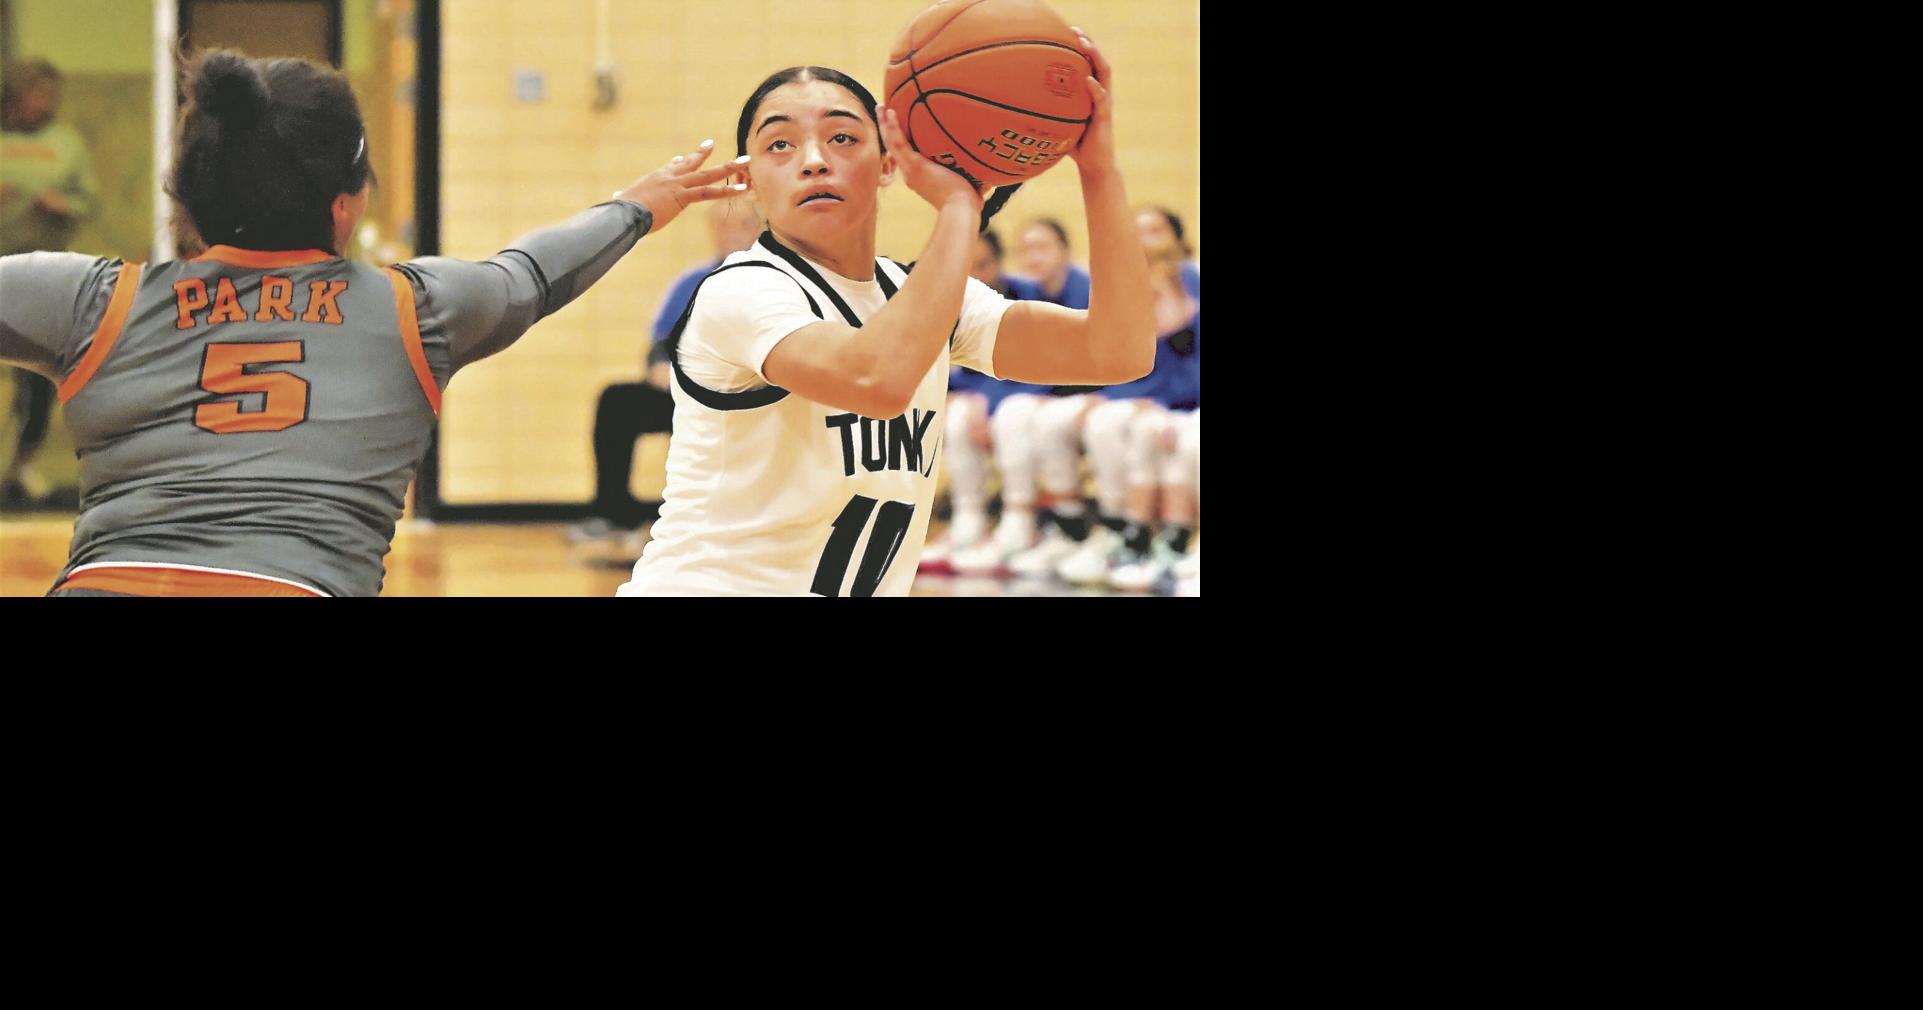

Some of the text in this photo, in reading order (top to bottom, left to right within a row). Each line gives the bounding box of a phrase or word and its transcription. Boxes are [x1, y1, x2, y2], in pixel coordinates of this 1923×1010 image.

[173, 275, 348, 330] PARK
[192, 339, 311, 434] 5
[825, 408, 939, 478] TONK
